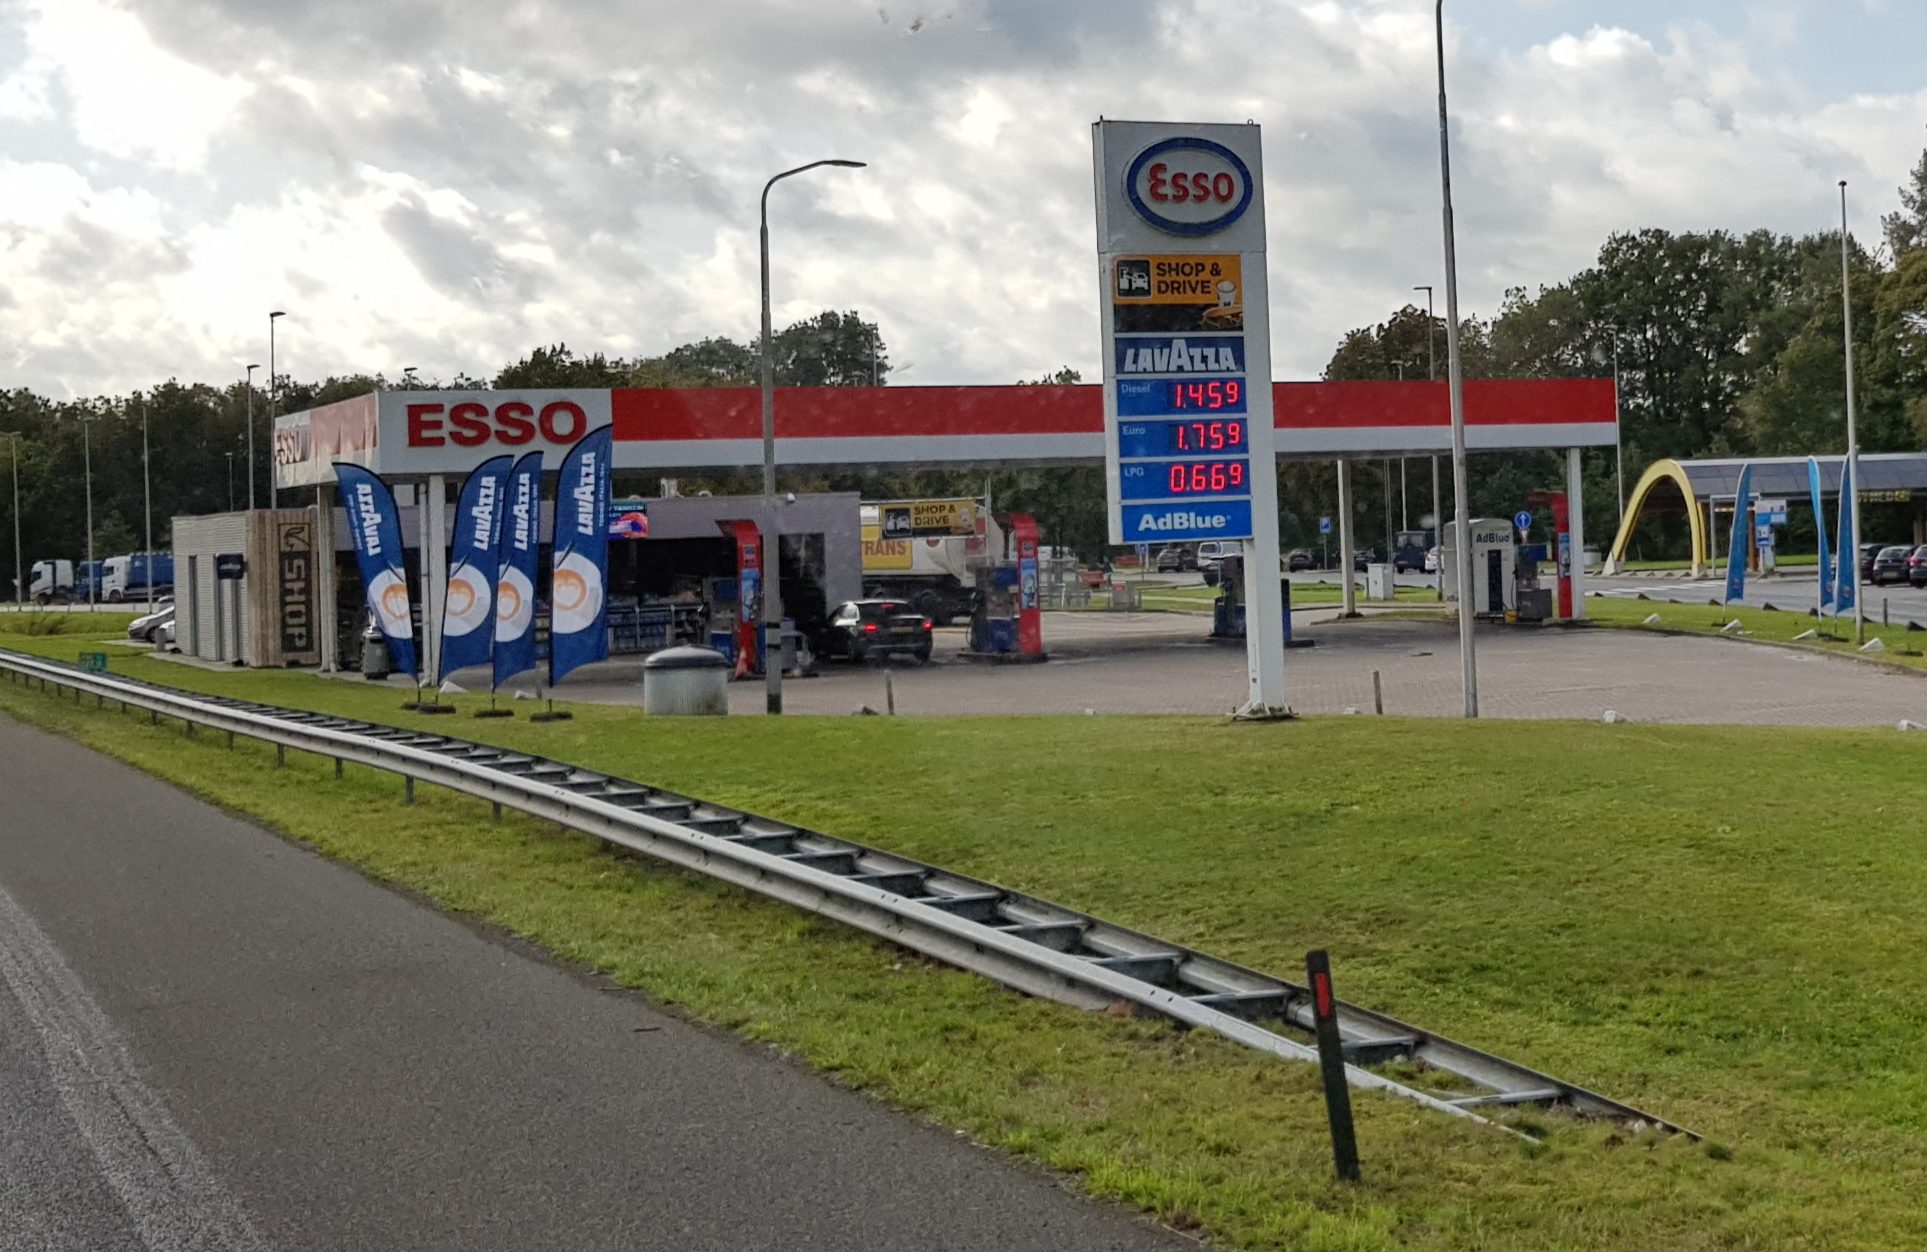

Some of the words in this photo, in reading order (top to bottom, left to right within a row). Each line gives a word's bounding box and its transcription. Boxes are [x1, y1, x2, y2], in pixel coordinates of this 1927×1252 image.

[1156, 262, 1206, 277] SHOP
[1210, 262, 1221, 276] &
[1157, 280, 1212, 295] DRIVE
[1123, 339, 1237, 373] LAVAZZA
[1121, 383, 1151, 394] Diesel
[1175, 381, 1239, 409] 1.459
[407, 401, 587, 447] ESSO
[1122, 426, 1147, 437] Euro
[1177, 422, 1242, 451] 1.759
[1124, 467, 1145, 477] LPG
[1169, 463, 1243, 493] 0.669
[573, 452, 596, 536] LAVAZZA
[471, 476, 496, 551] LAVAZZA
[513, 473, 530, 551] LAVAZZA
[914, 504, 946, 516] SHOP
[947, 503, 956, 513] &
[914, 515, 950, 526] DRIVE
[285, 558, 307, 648] SHOP
